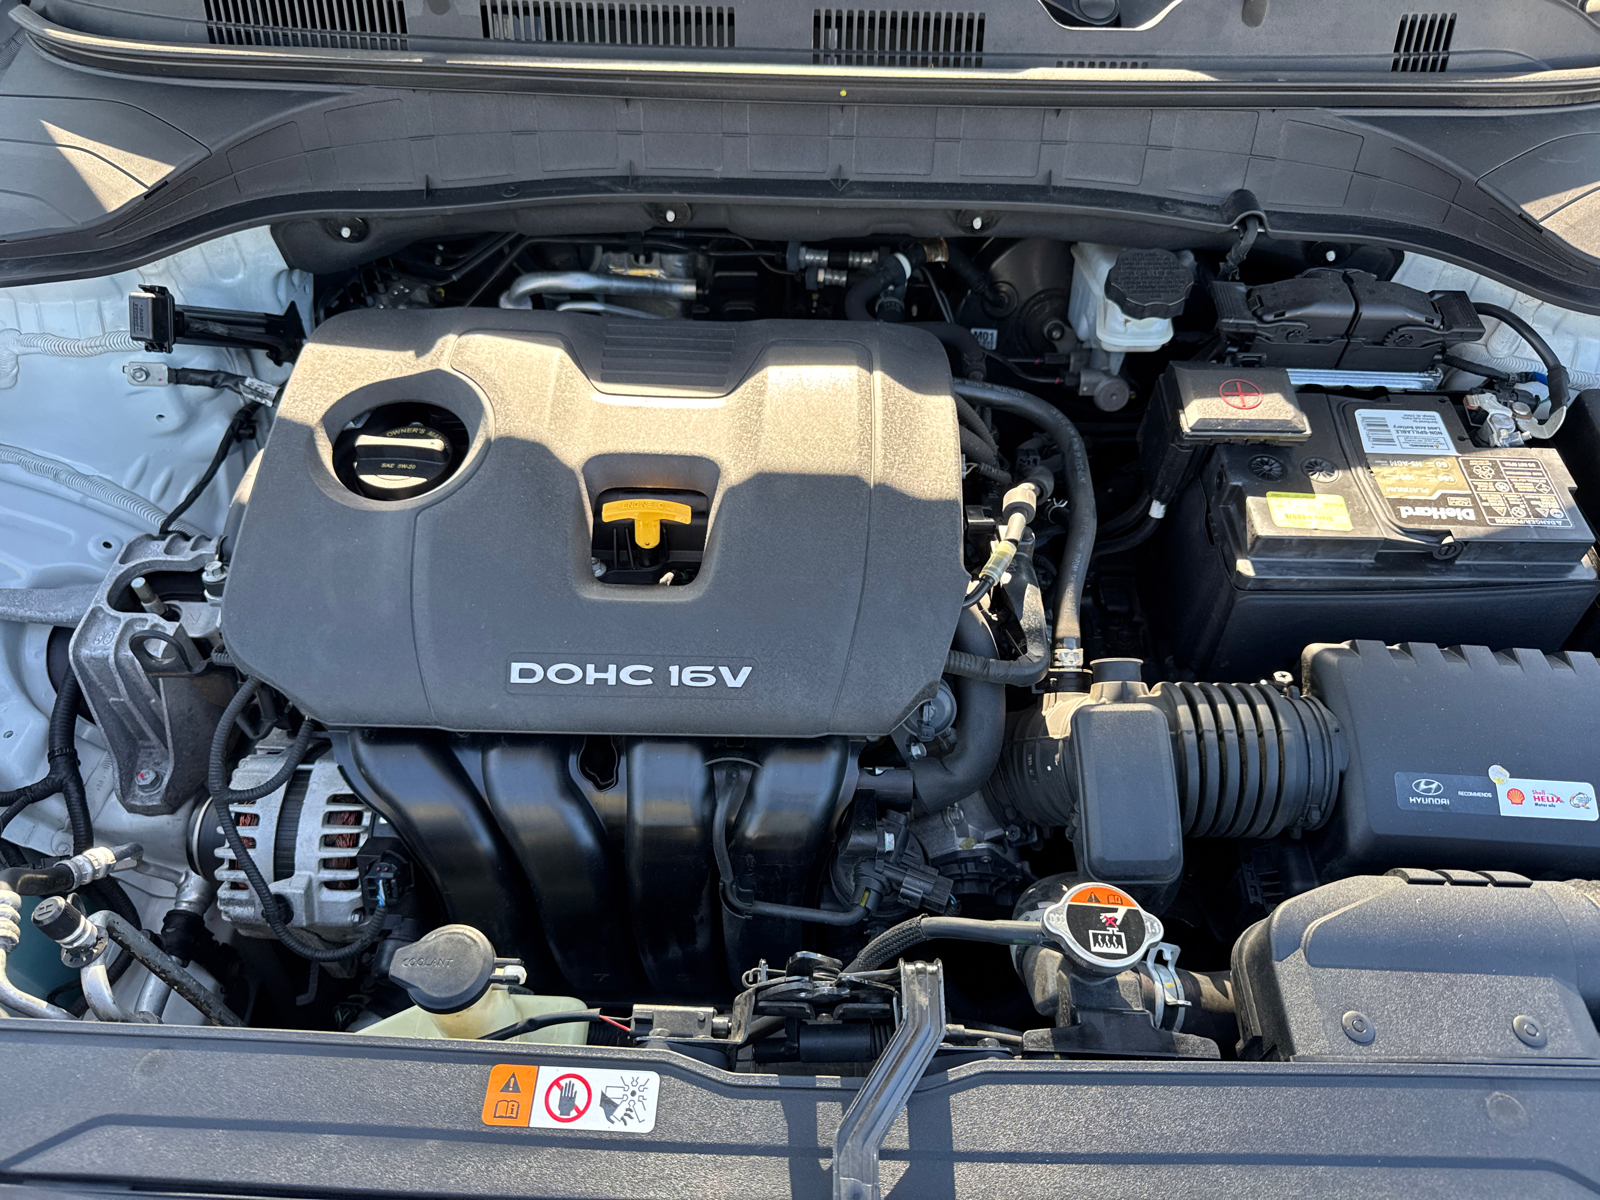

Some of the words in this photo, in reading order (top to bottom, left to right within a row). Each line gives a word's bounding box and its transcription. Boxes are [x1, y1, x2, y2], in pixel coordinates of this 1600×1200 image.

[974, 331, 994, 342] M01
[386, 427, 426, 438] OWNER'S
[1385, 486, 1430, 494] PLATINUM
[622, 501, 653, 509] ENGINE
[1399, 505, 1477, 521] DieHard
[510, 662, 654, 686] DOHC
[668, 664, 753, 688] 16V
[1457, 790, 1492, 798] RECOMMENDS
[1533, 795, 1563, 804] HELIX
[1409, 796, 1450, 806] HYUNDAI
[1146, 921, 1159, 934] 1.1
[401, 957, 453, 968] COOLANT
